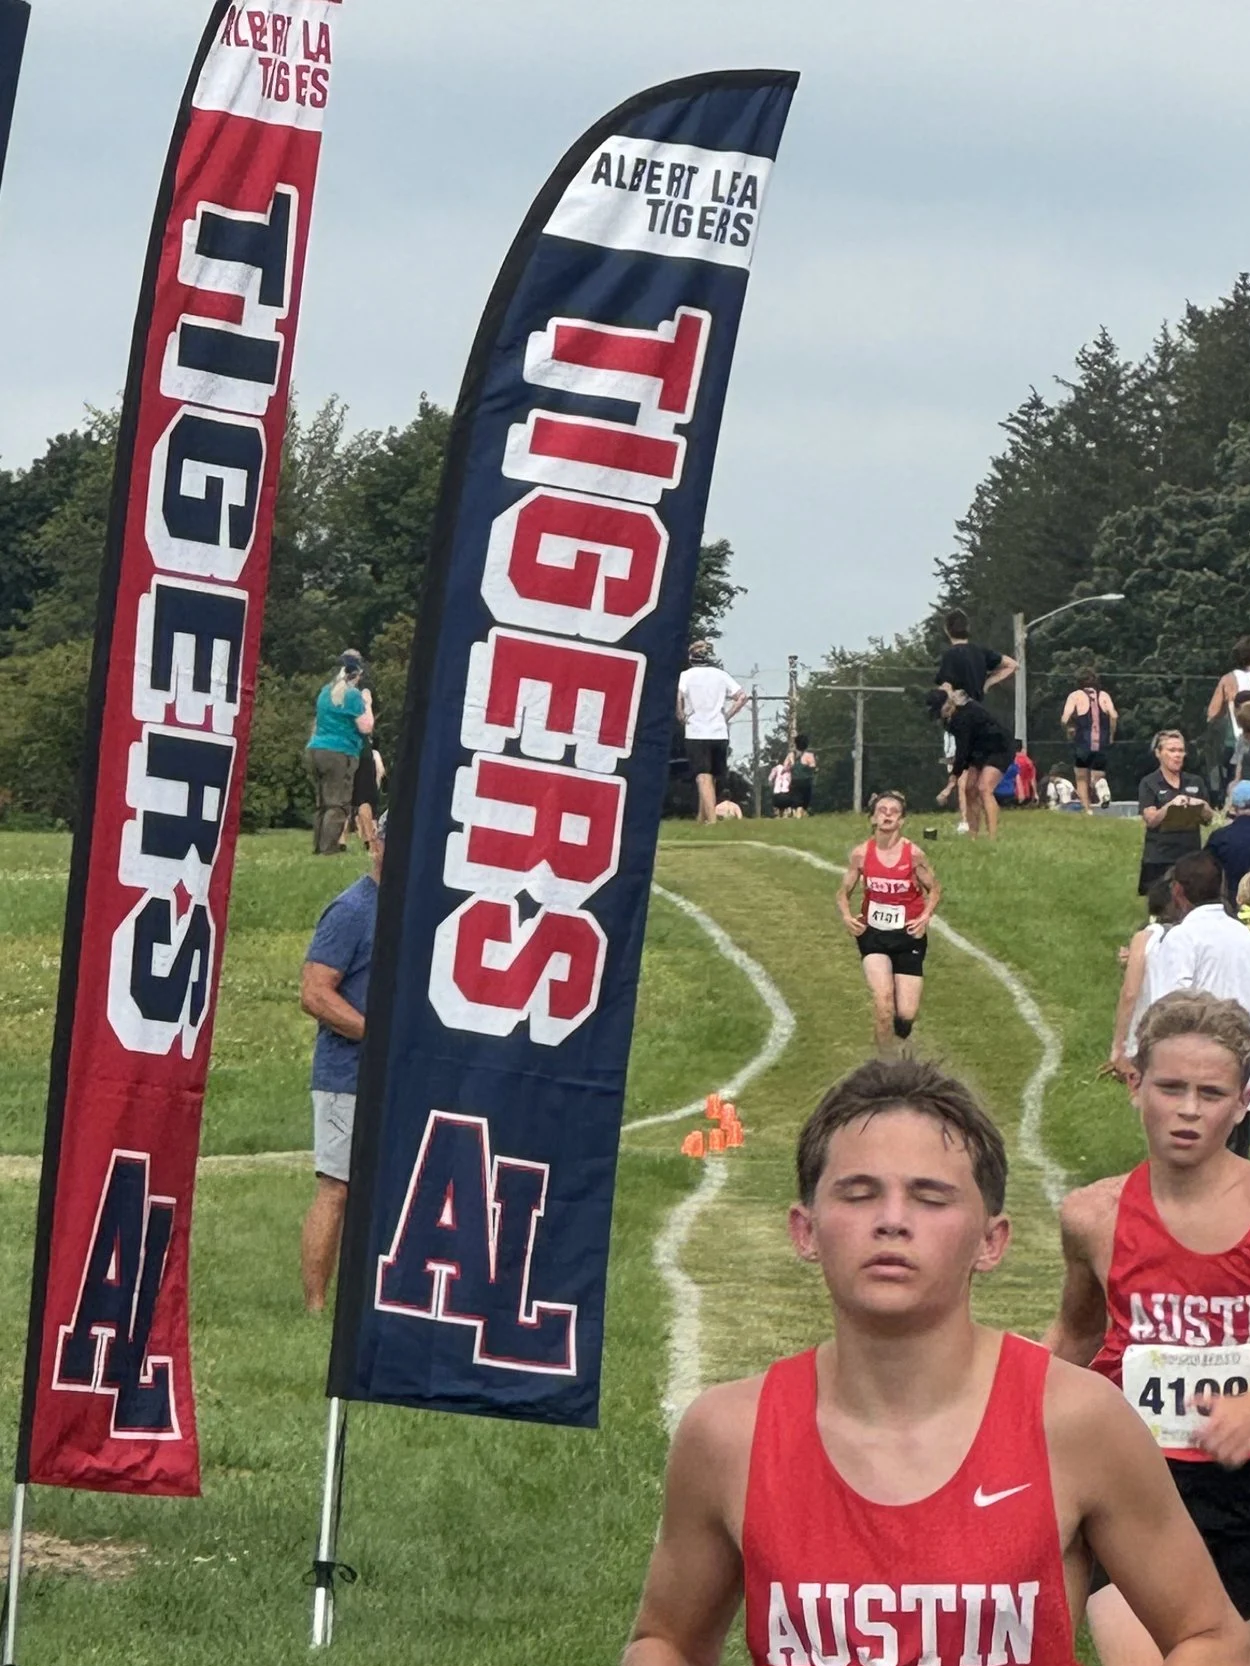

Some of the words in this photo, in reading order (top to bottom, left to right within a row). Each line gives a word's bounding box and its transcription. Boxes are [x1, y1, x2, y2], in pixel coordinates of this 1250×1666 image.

[258, 57, 329, 108] TIGES
[591, 152, 699, 200] ALBERT
[710, 169, 758, 209] LEA
[646, 198, 753, 247] TIGERS
[107, 183, 298, 1061] TIGERS
[429, 305, 713, 1047] TIGERS
[52, 1148, 182, 1441] AL
[373, 1109, 578, 1377] AL
